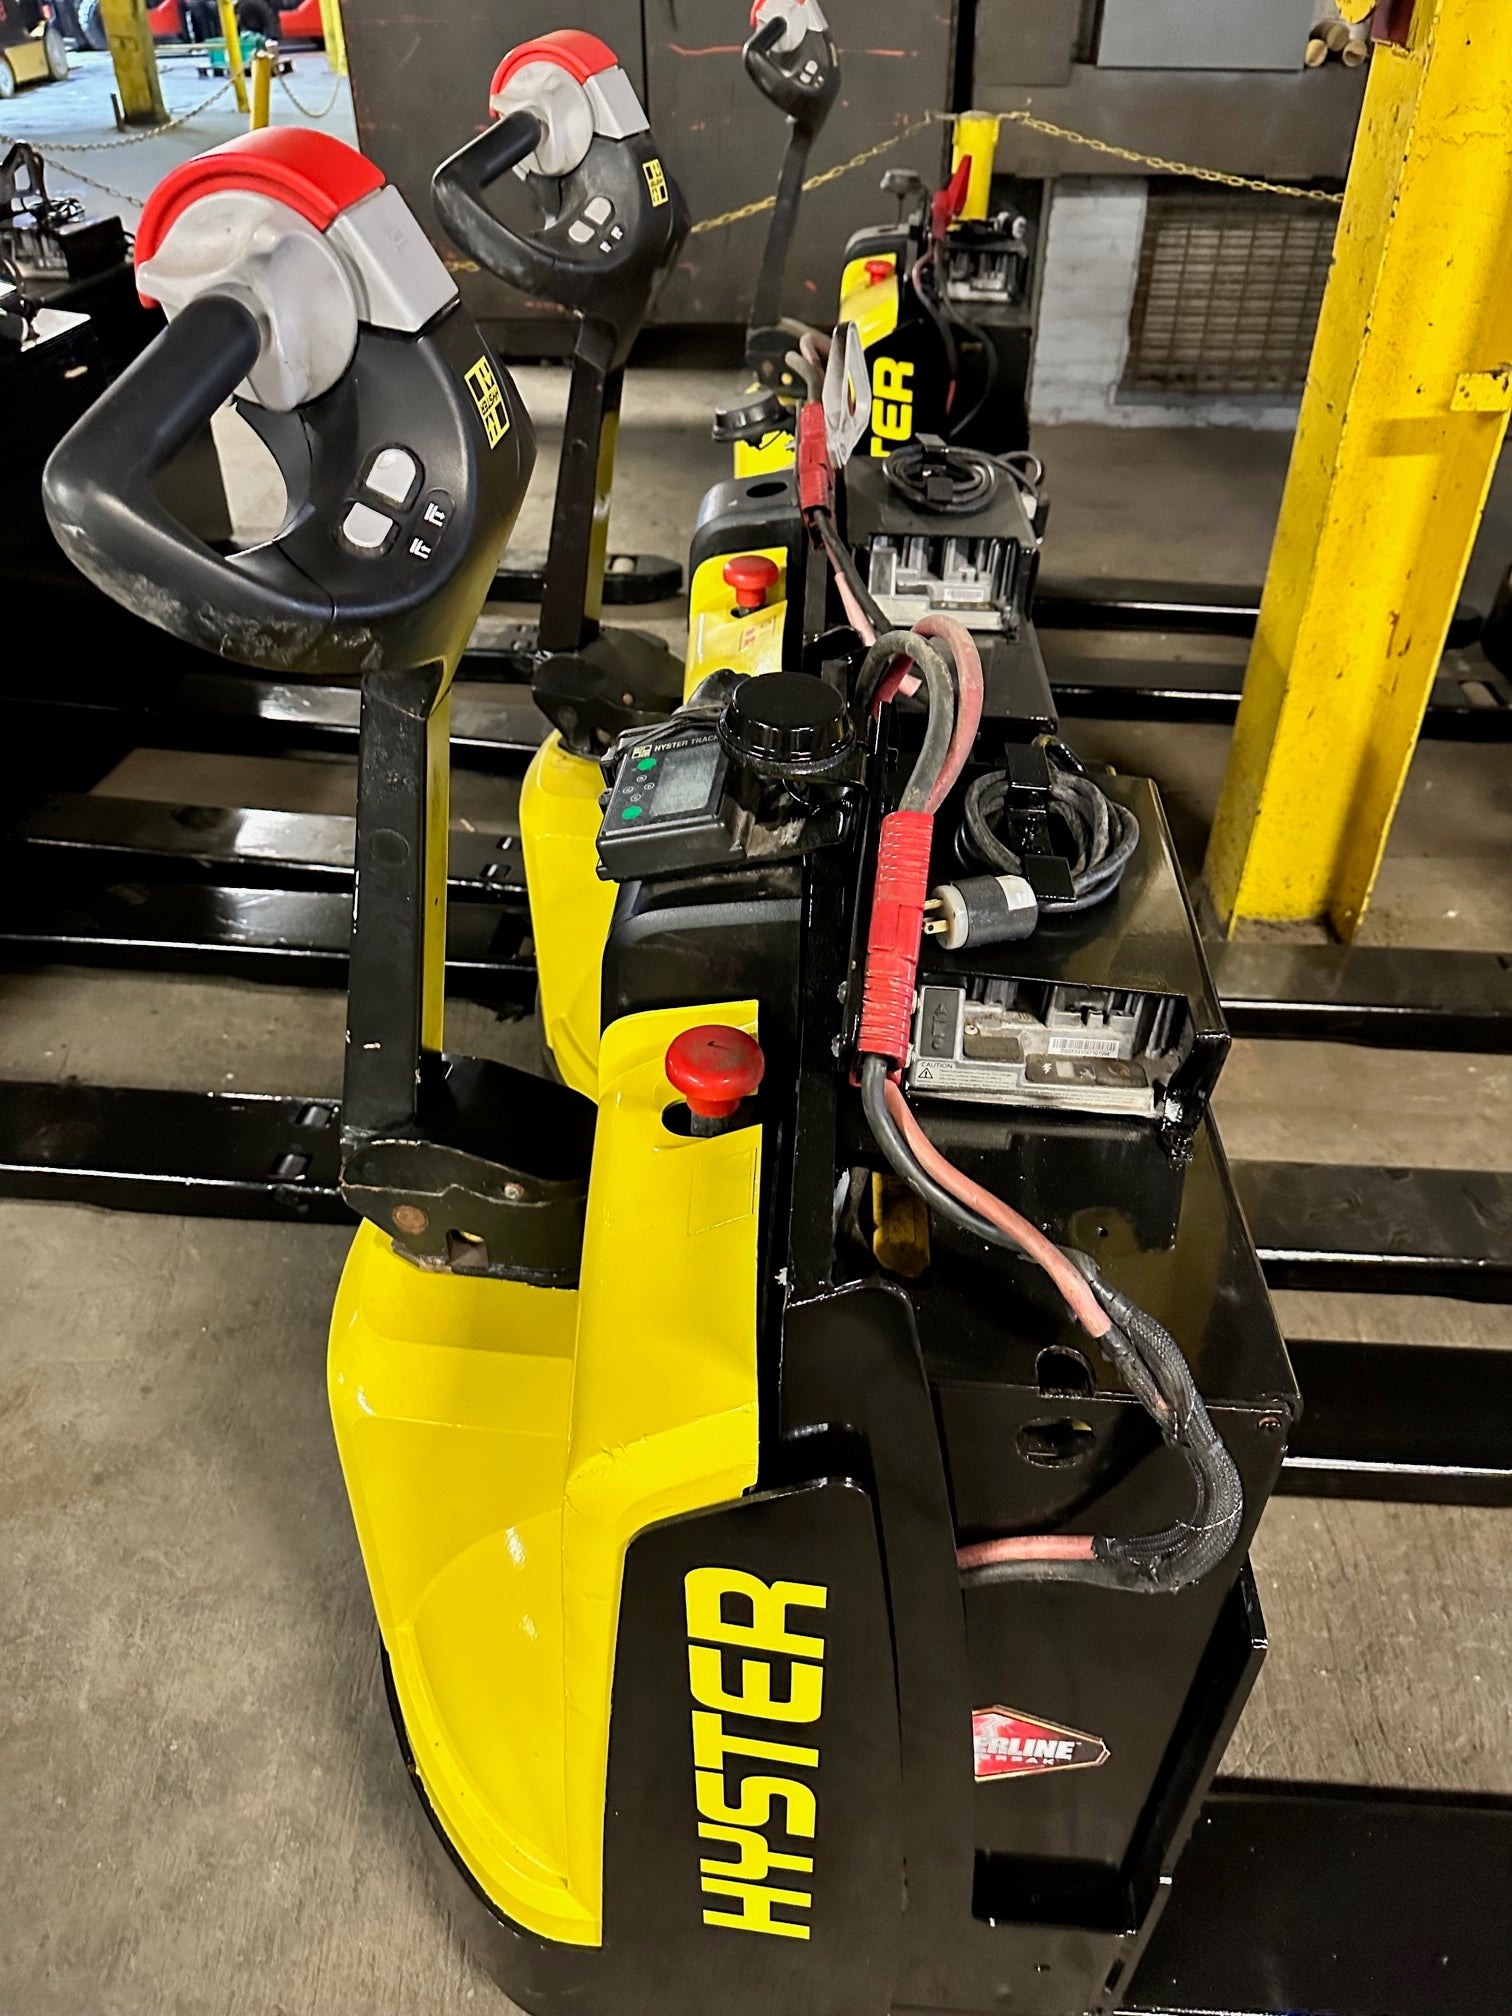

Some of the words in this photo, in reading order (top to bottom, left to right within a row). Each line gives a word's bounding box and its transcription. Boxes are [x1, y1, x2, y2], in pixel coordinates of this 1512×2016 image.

[654, 739, 688, 752] HYSTER
[921, 1061, 953, 1069] CAUTION
[684, 1567, 828, 1940] HYSTER
